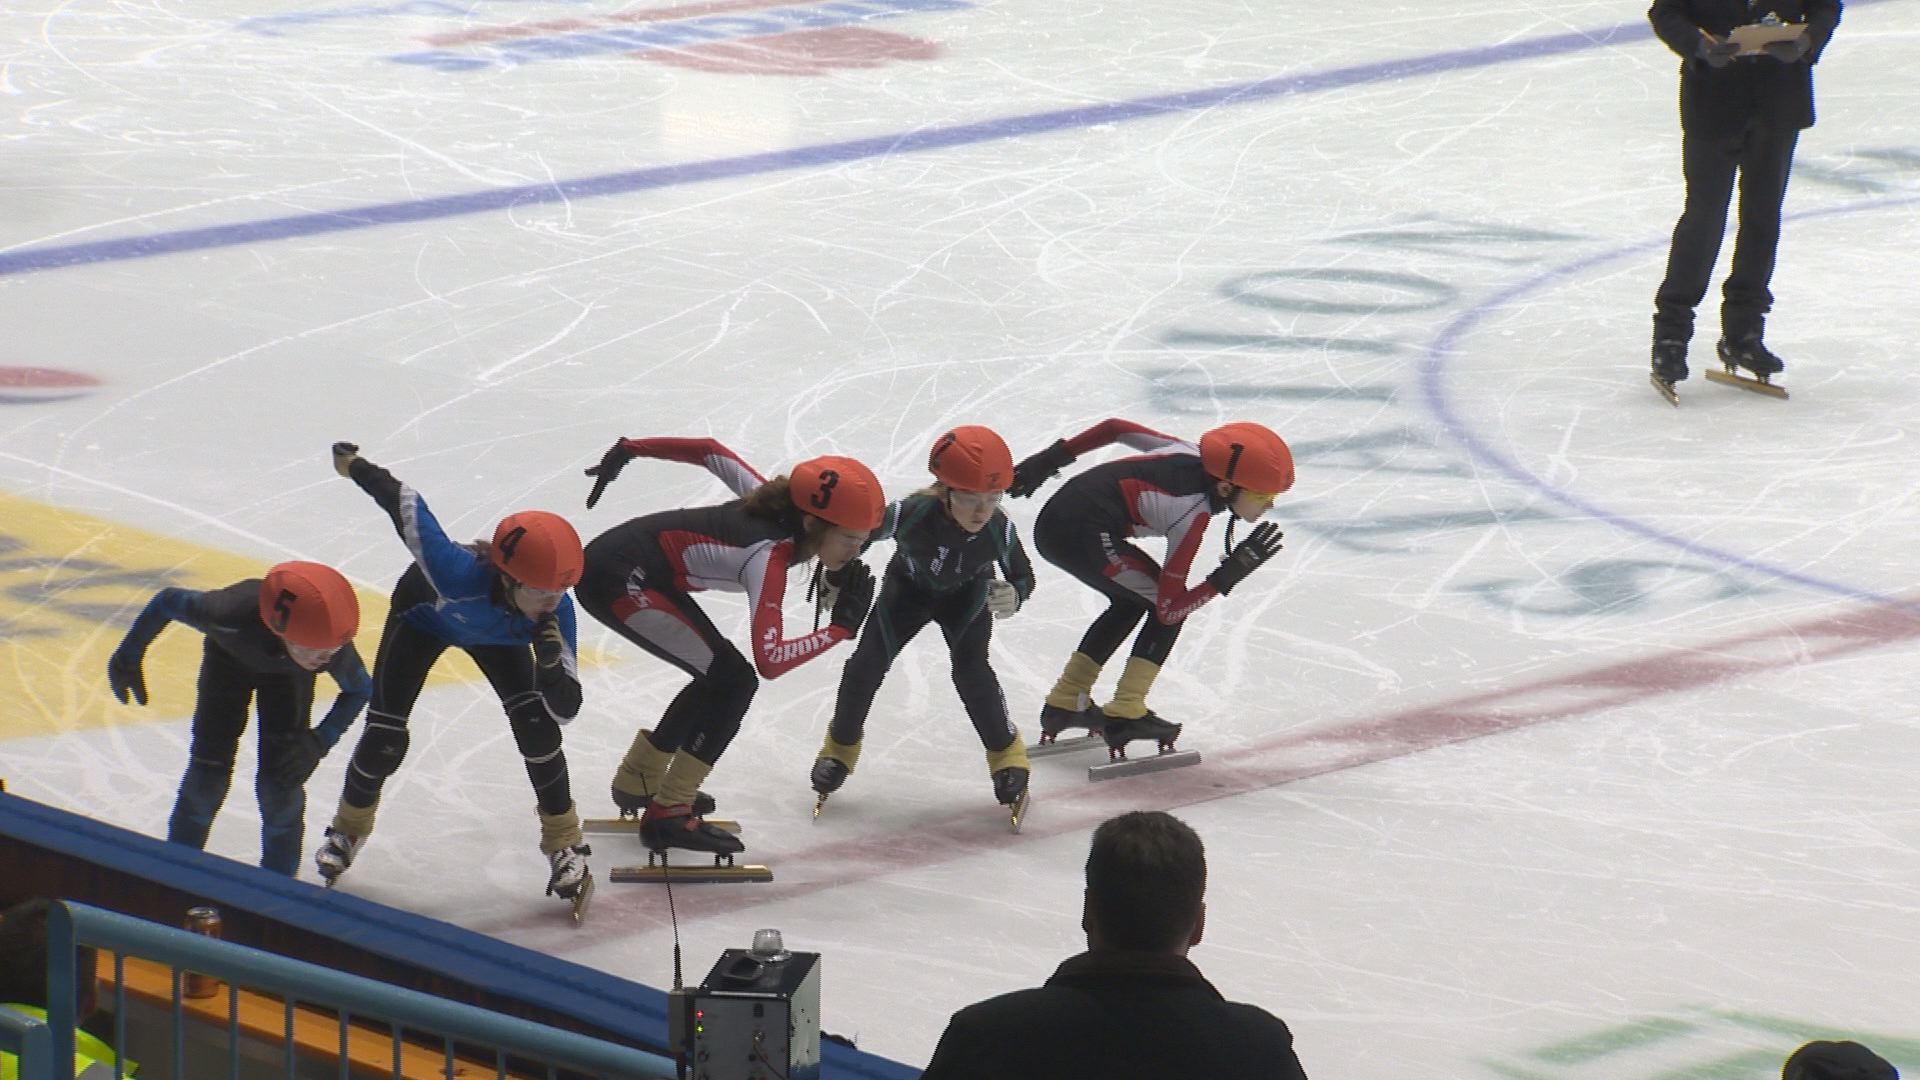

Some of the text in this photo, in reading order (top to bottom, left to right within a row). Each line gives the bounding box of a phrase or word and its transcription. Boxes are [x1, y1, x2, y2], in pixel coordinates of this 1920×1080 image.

[1226, 443, 1243, 480] 1
[810, 469, 840, 509] 3
[499, 526, 527, 564] 4
[270, 588, 298, 632] 5
